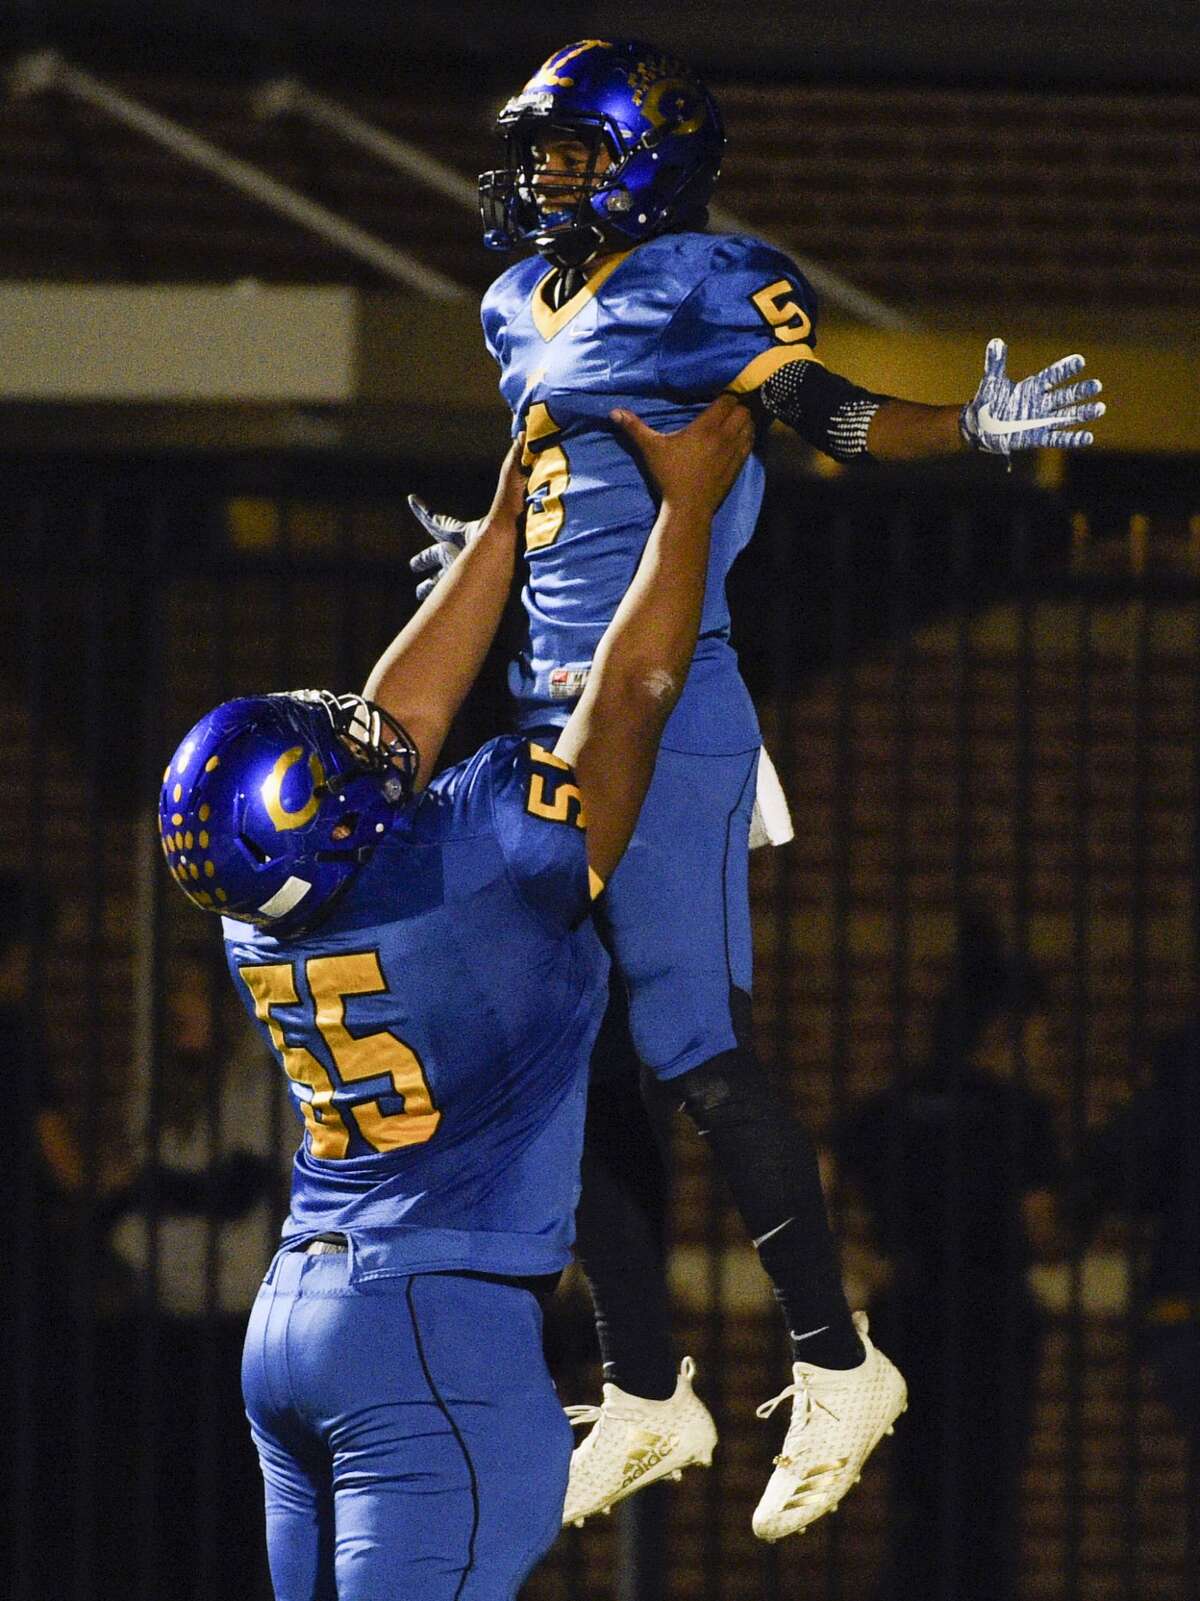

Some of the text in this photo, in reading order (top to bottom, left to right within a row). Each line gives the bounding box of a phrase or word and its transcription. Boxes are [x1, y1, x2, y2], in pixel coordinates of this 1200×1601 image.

[752, 279, 812, 343] 5
[260, 746, 325, 832] C
[239, 952, 441, 1159] 55
